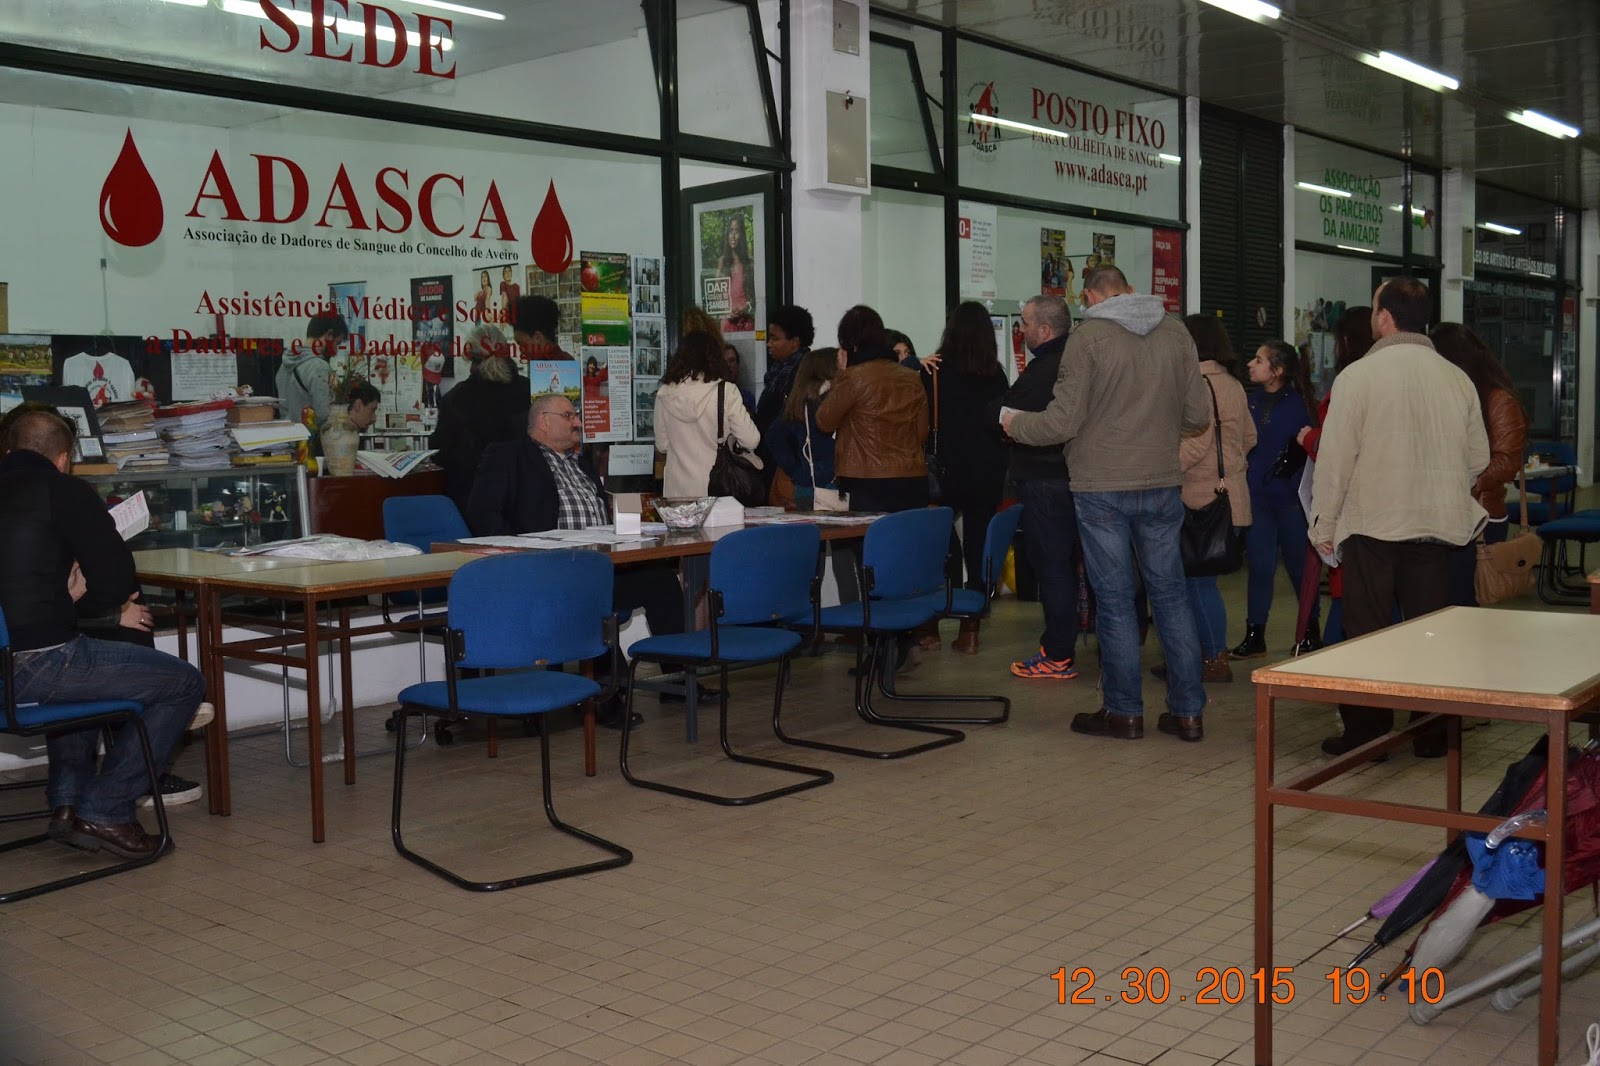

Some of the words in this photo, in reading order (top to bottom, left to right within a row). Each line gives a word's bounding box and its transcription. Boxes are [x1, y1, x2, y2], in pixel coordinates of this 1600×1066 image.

[259, 0, 457, 80] SEDE
[1031, 87, 1109, 136] POSTO
[1115, 108, 1165, 150] FIXO
[971, 138, 998, 154] ADASCA
[1031, 130, 1060, 147] PARA
[1061, 134, 1113, 157] COLHEITA
[1115, 144, 1127, 161] DE
[1128, 149, 1165, 169] SANGUE
[1054, 160, 1148, 196] www.adasca.pt
[1324, 167, 1381, 200] ASSOCIAÇÃO
[184, 148, 519, 242] ADASCA
[1319, 194, 1333, 214] OS
[1336, 197, 1384, 224] PARCEIROS
[183, 226, 258, 246] Associação
[261, 231, 277, 245] de
[281, 233, 333, 249] Dadores
[336, 237, 351, 250] de
[353, 238, 397, 255] Sangue
[400, 241, 414, 254] do
[416, 242, 468, 258] Concelho
[470, 246, 483, 259] de
[485, 249, 519, 261] Aveiro
[1323, 217, 1337, 238] DA
[1339, 221, 1380, 245] AMIZADE
[1483, 251, 1490, 265] DE
[1490, 252, 1511, 269] ARTISTAS
[1511, 256, 1515, 269] E
[1536, 261, 1543, 274] DO
[707, 281, 728, 293] DAR
[194, 289, 338, 320] Assistência
[346, 295, 430, 322] Médica
[438, 306, 449, 323] e
[455, 299, 518, 325] Social
[708, 300, 730, 310] SANGUE
[145, 335, 161, 355] a
[170, 328, 286, 357] Dadores
[291, 337, 303, 356] e
[311, 332, 443, 359] ex-Dadores
[451, 335, 473, 358] de
